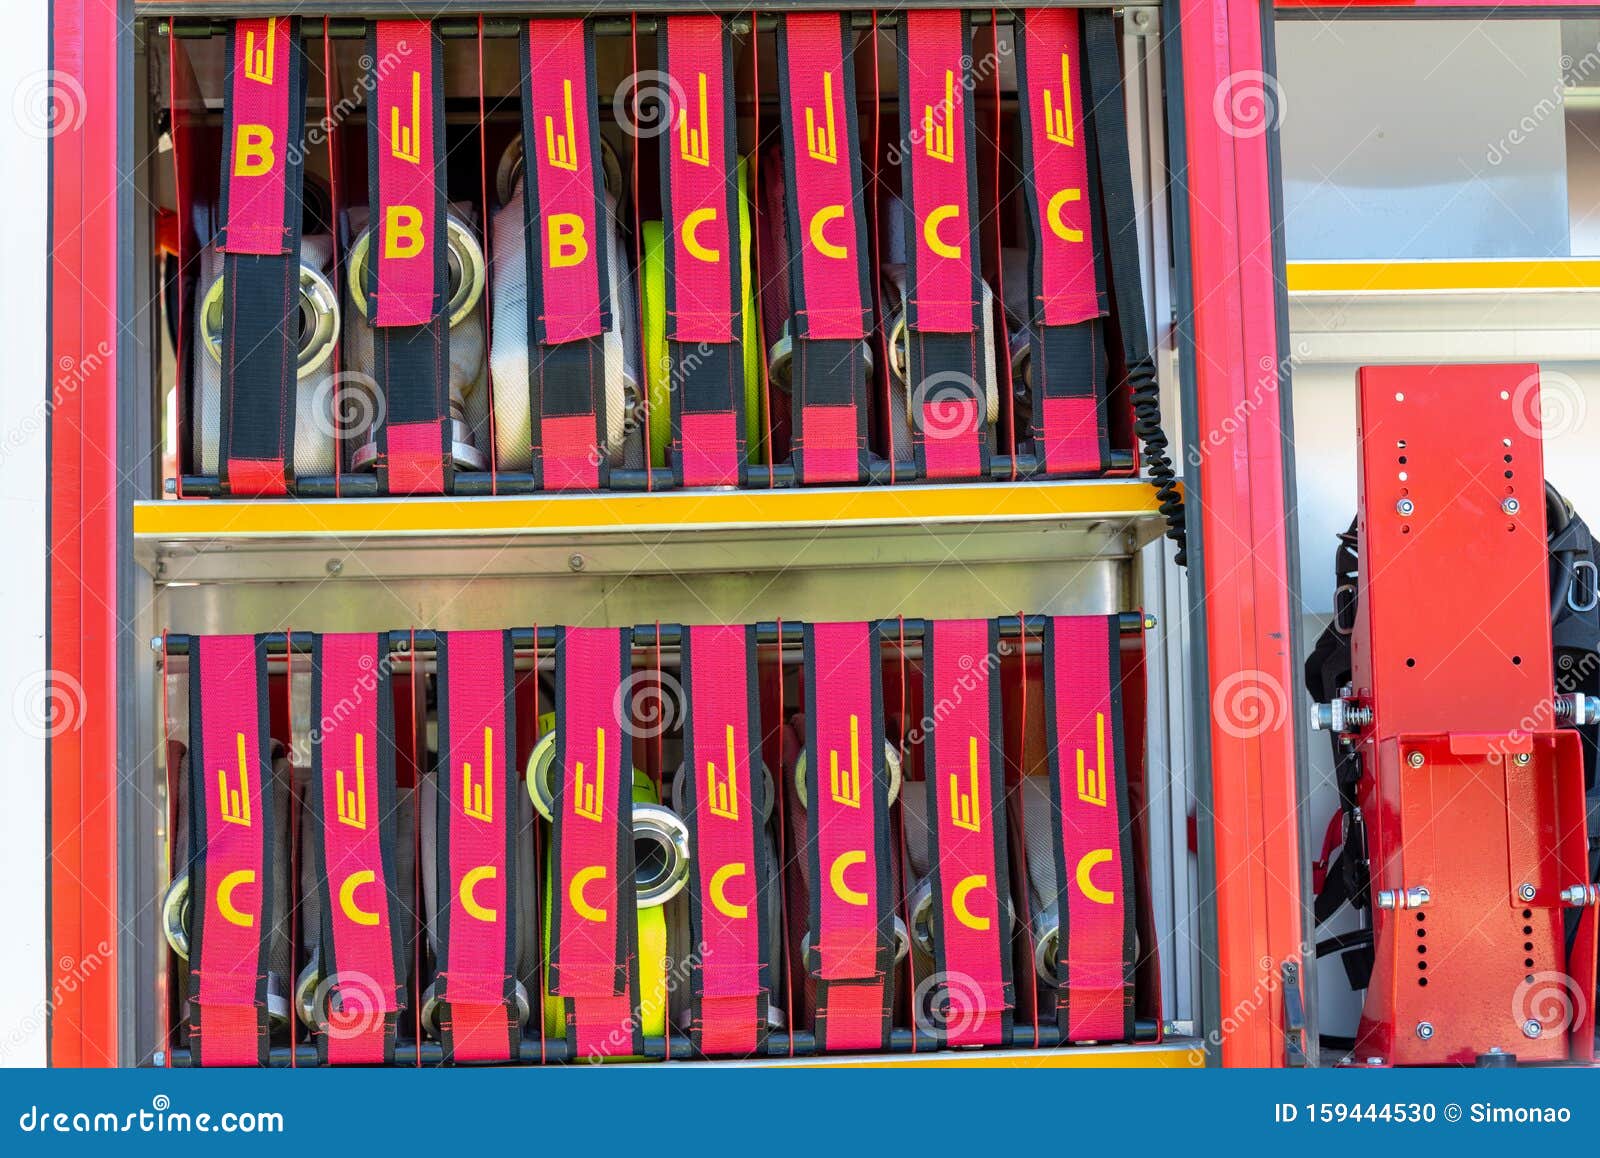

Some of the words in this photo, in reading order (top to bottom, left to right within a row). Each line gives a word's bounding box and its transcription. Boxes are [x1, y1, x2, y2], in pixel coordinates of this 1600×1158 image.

[235, 124, 275, 177] B
[385, 205, 425, 259] B
[548, 213, 588, 268] B
[682, 208, 720, 262] C
[809, 205, 847, 259] C
[924, 205, 961, 259] C
[1047, 188, 1083, 242] C
[216, 870, 255, 927] C
[339, 871, 379, 925] C
[459, 866, 496, 921] C
[569, 866, 607, 922] C
[709, 863, 747, 918] C
[830, 851, 867, 905] C
[951, 875, 990, 930] C
[1076, 849, 1114, 904] C
